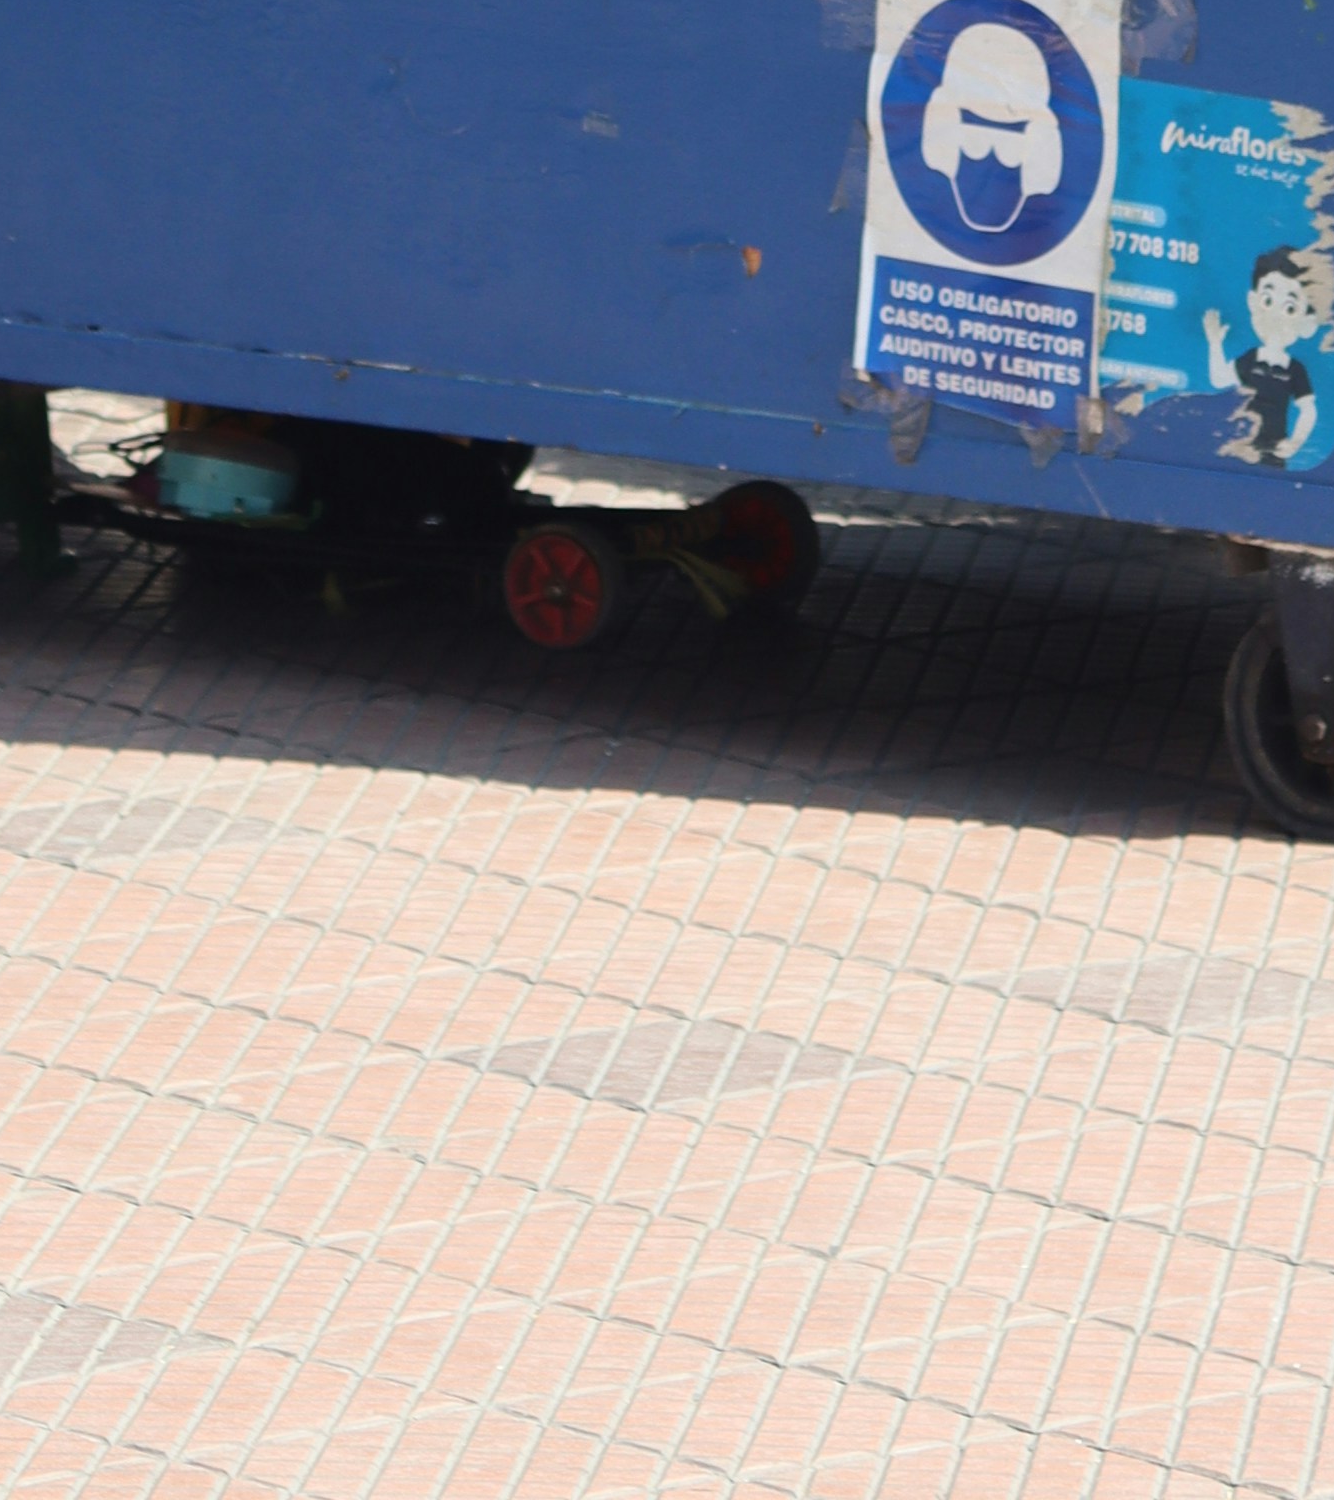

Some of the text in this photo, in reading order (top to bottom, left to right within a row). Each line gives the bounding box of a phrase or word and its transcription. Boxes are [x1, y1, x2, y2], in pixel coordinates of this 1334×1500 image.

[1129, 232, 1164, 258] 708
[1167, 239, 1200, 264] 318
[890, 278, 1078, 329] USO OBLIGATORIO
[879, 305, 1086, 359] CASCO, PROTECTOR
[879, 334, 1082, 386] AUDITIVO Y LENTES
[903, 365, 1057, 410] DE SEGURIDAD
